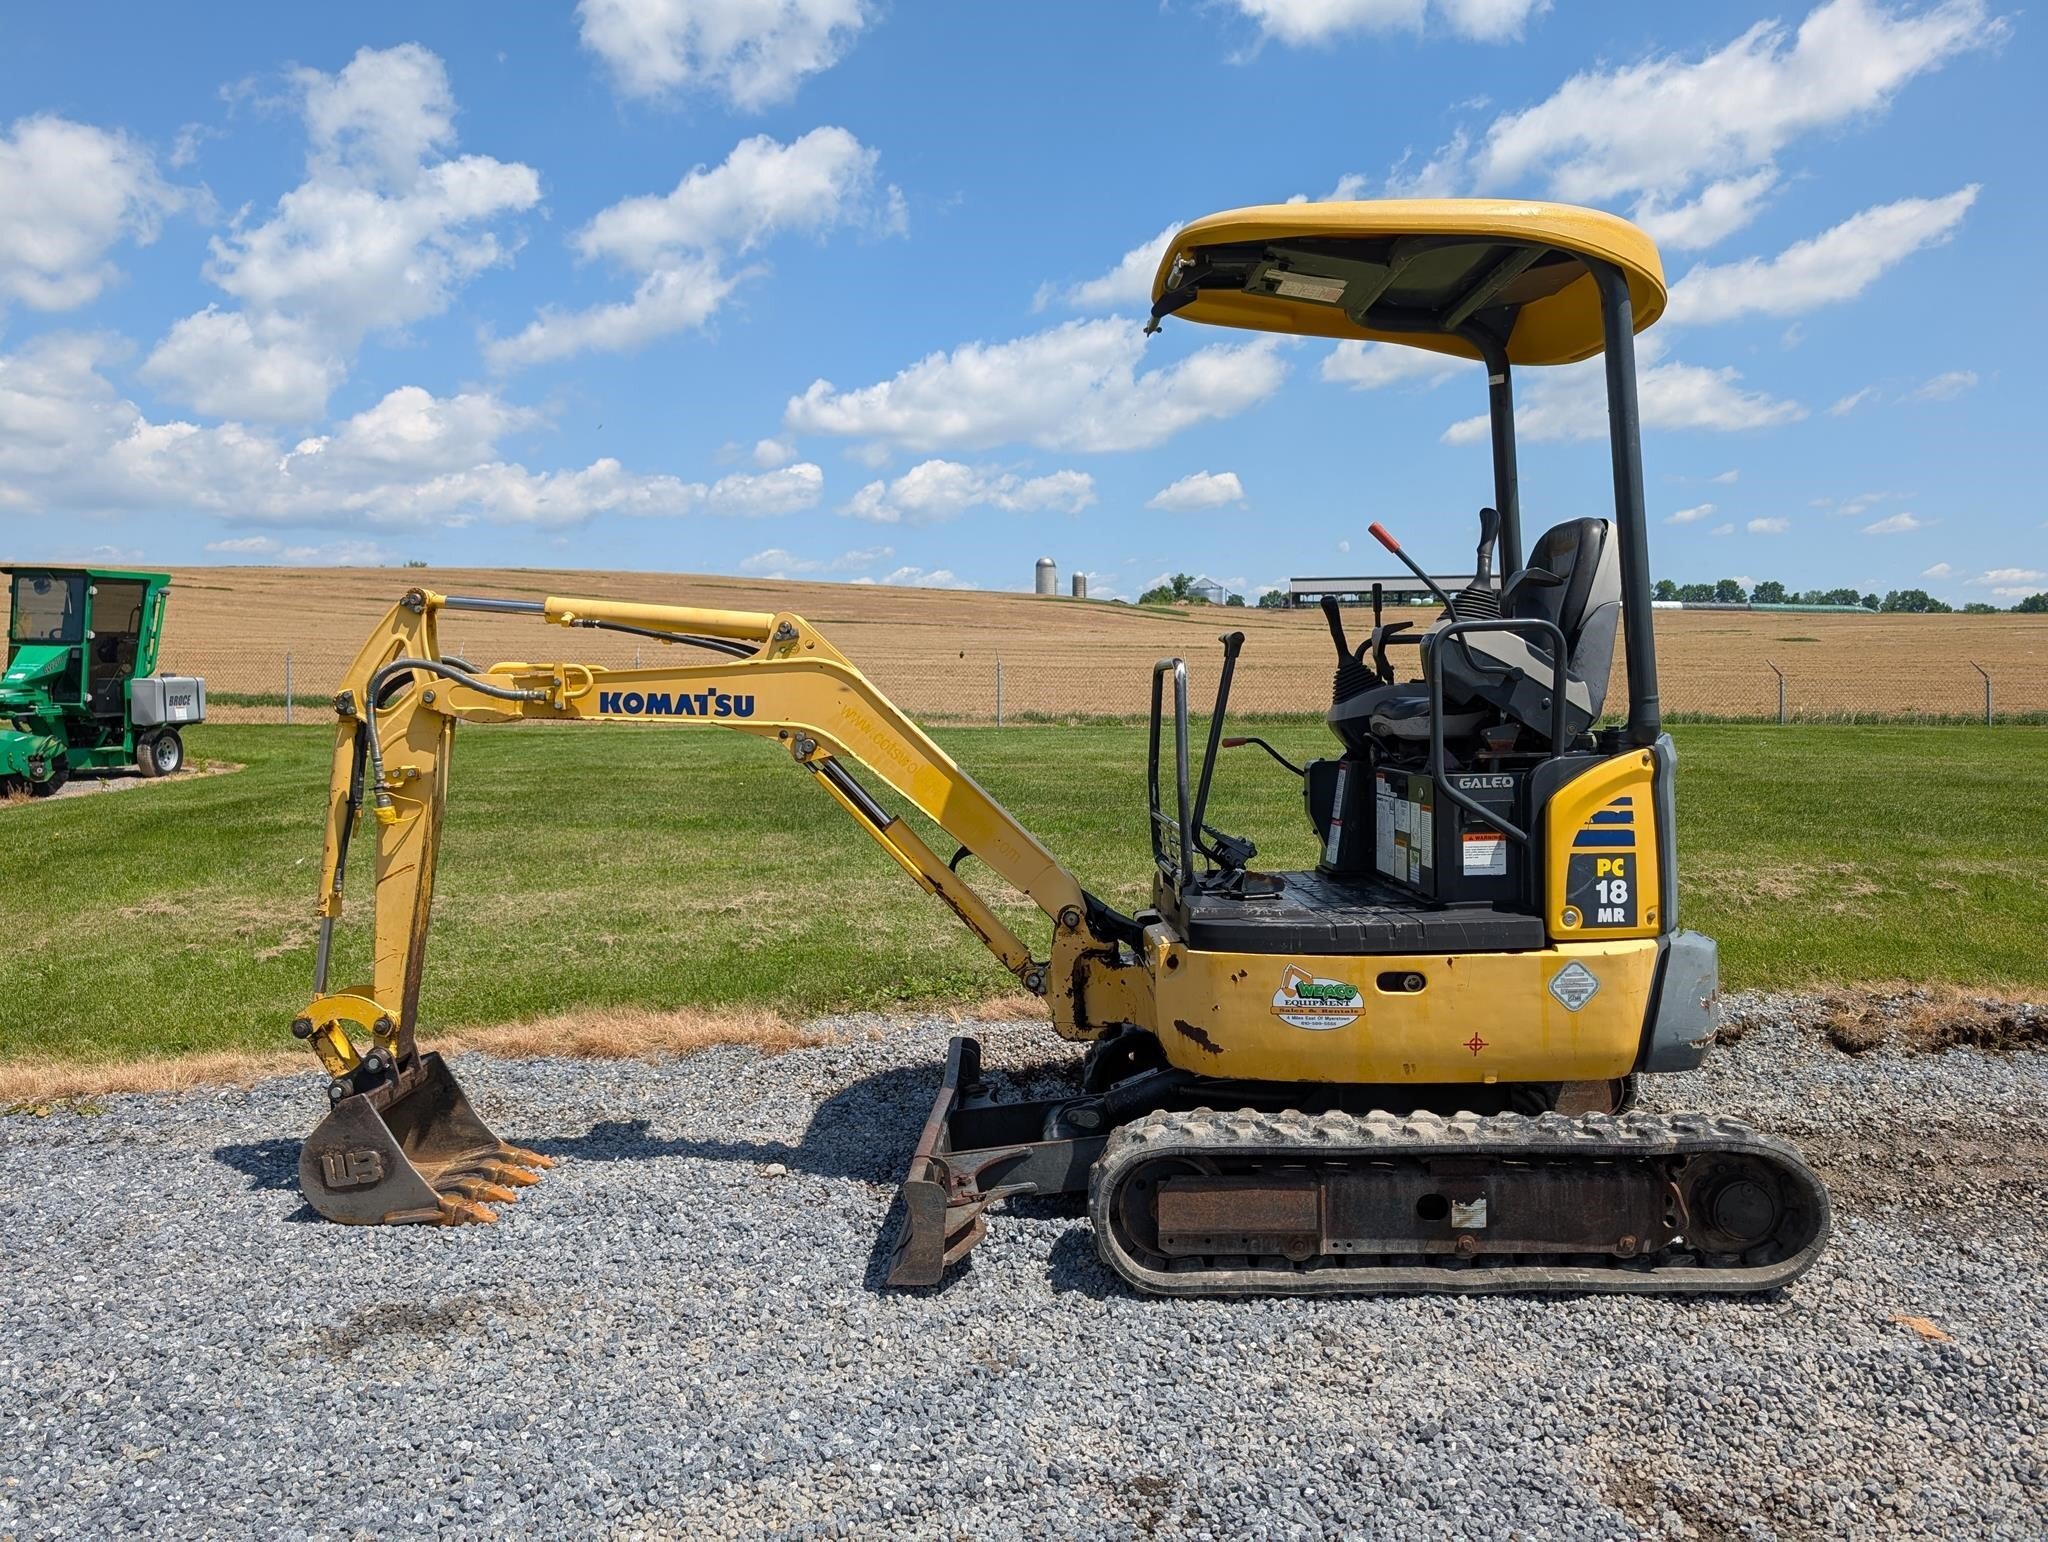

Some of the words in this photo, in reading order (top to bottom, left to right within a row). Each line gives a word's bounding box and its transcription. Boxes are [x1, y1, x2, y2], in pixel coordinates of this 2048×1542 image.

[169, 695, 191, 706] BROCE
[600, 688, 754, 717] KOMATSU
[1459, 777, 1514, 789] GALEO
[1596, 858, 1624, 877] PC
[1595, 879, 1628, 904] 18
[1597, 907, 1625, 923] MR
[1284, 999, 1351, 1007] EQUIPMENT
